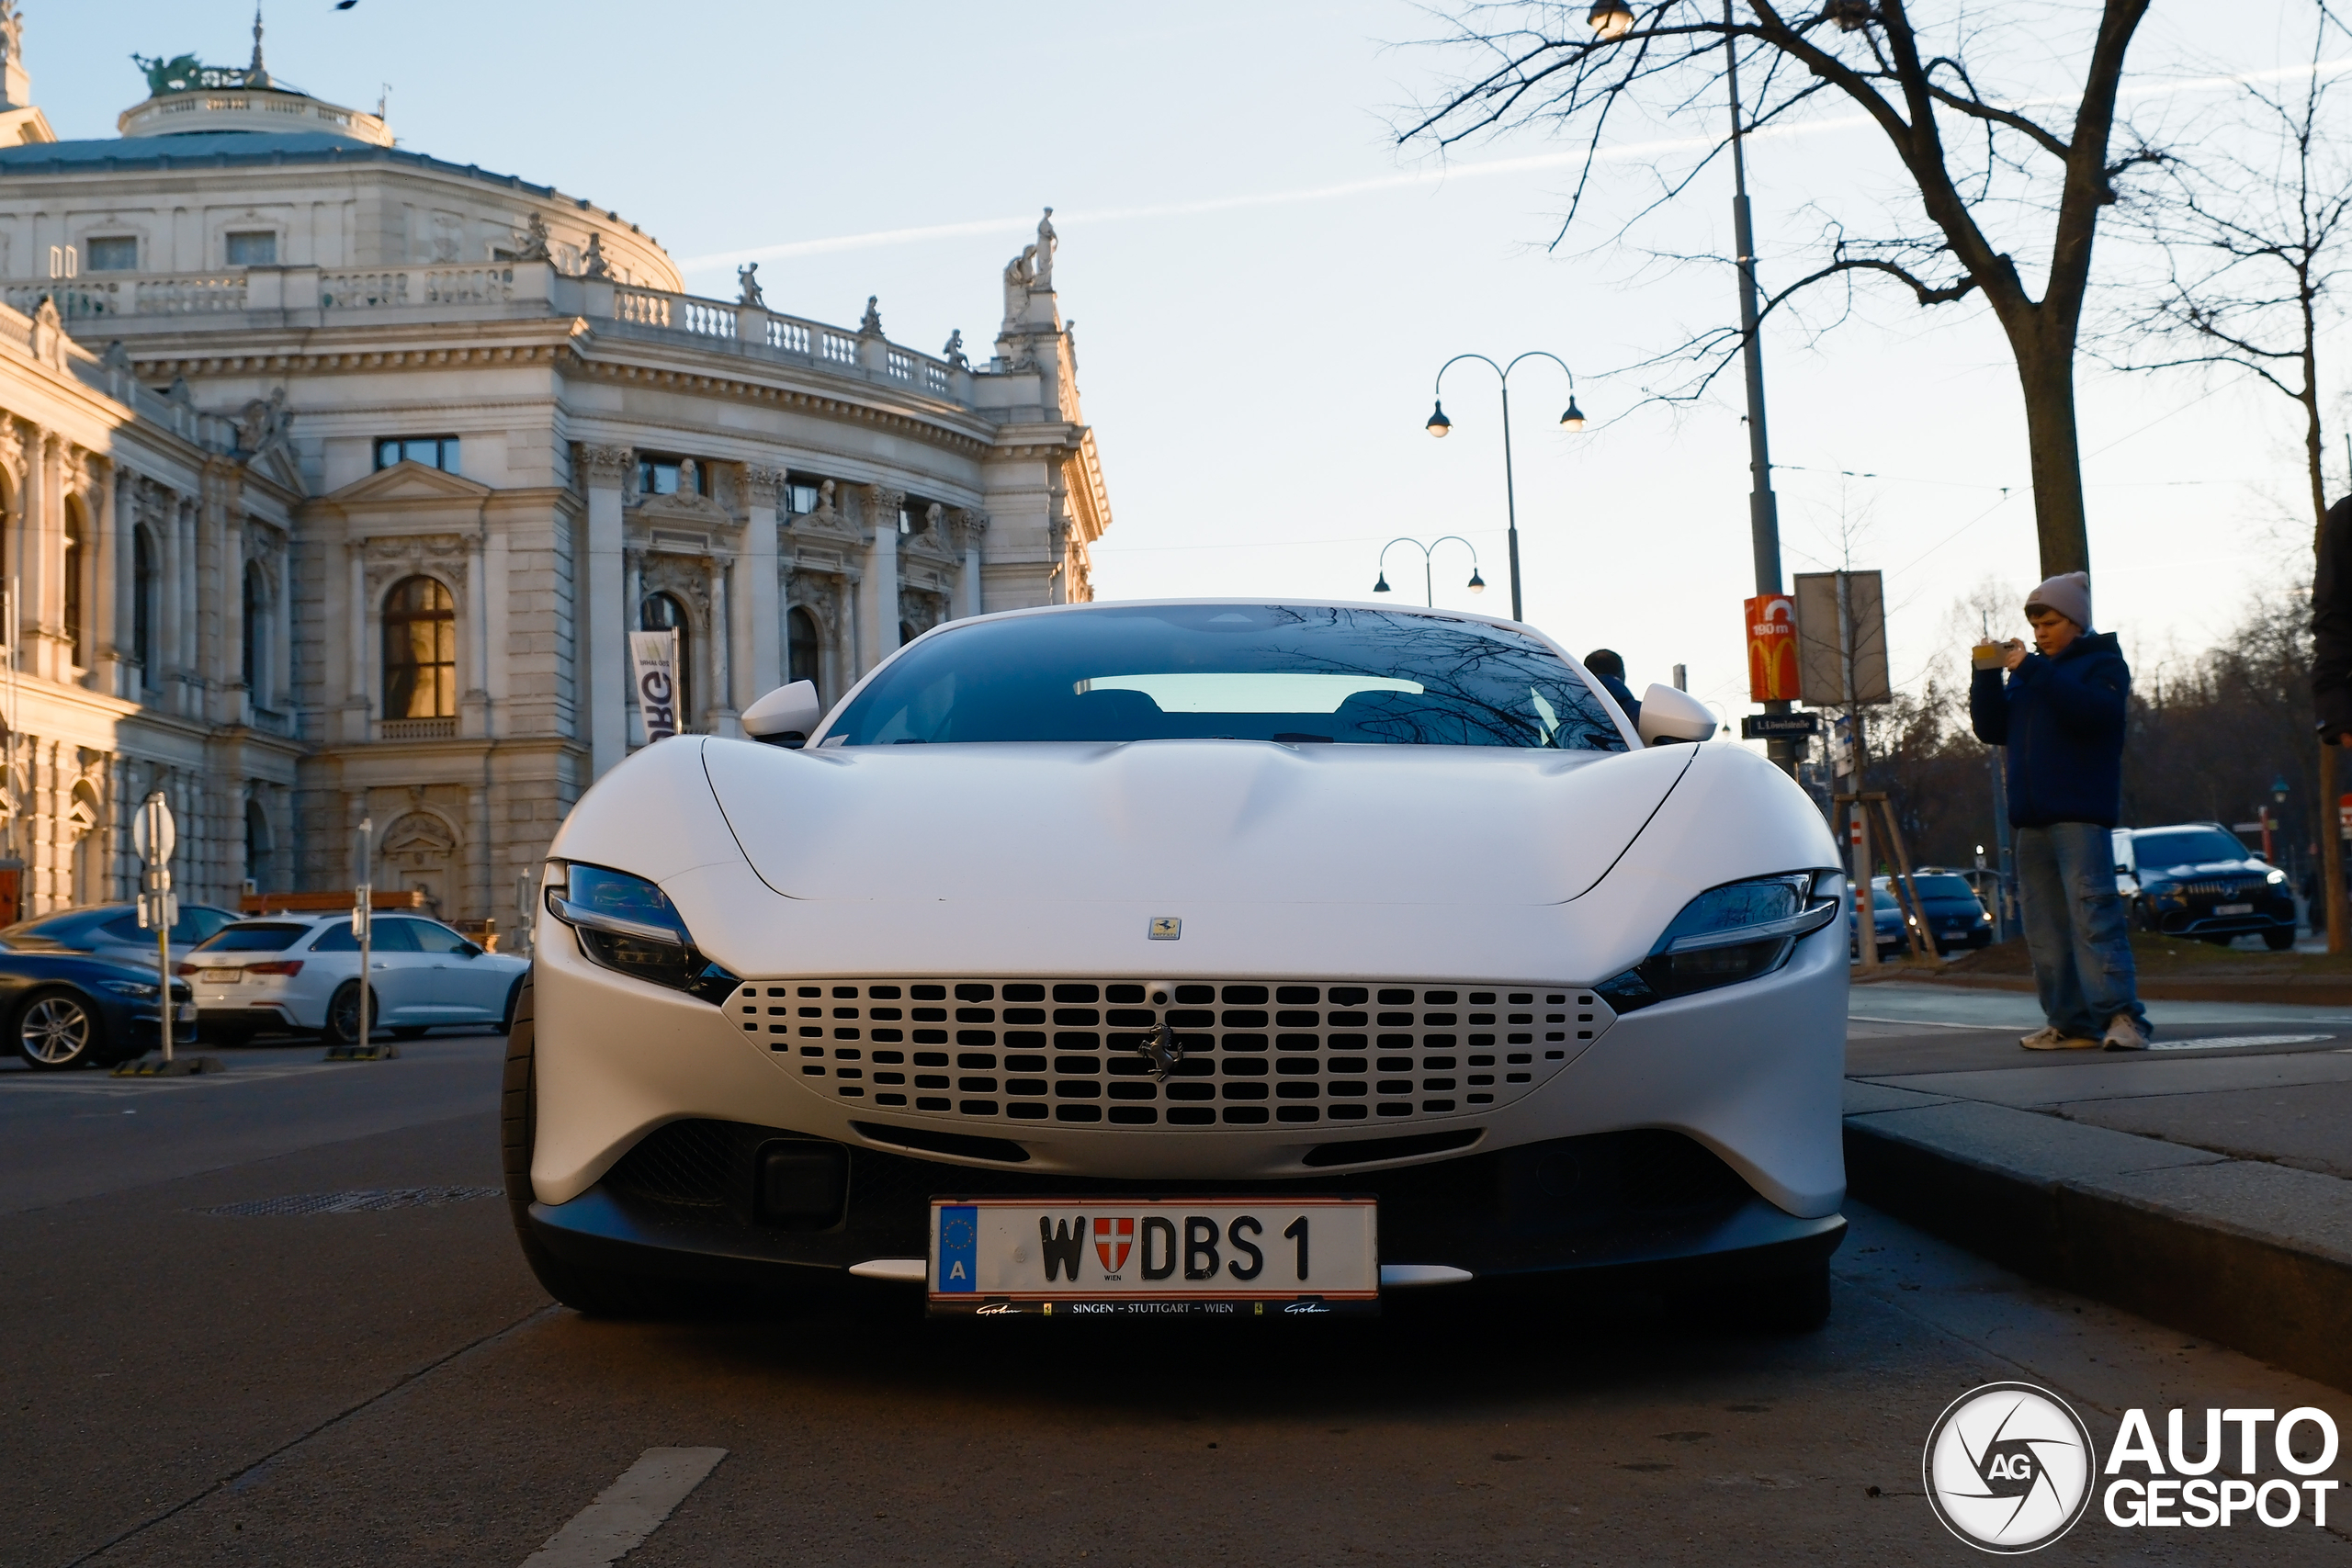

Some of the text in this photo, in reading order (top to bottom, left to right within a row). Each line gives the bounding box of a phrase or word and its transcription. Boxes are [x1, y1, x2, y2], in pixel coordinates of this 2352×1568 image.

[1752, 623, 1774, 636] 190
[1039, 1215, 1309, 1281] W DBS 1
[949, 1260, 966, 1280] A
[1072, 1303, 1114, 1314] SINGEN
[1127, 1303, 1191, 1314] STUTTGART
[1204, 1303, 1234, 1314] WIEN
